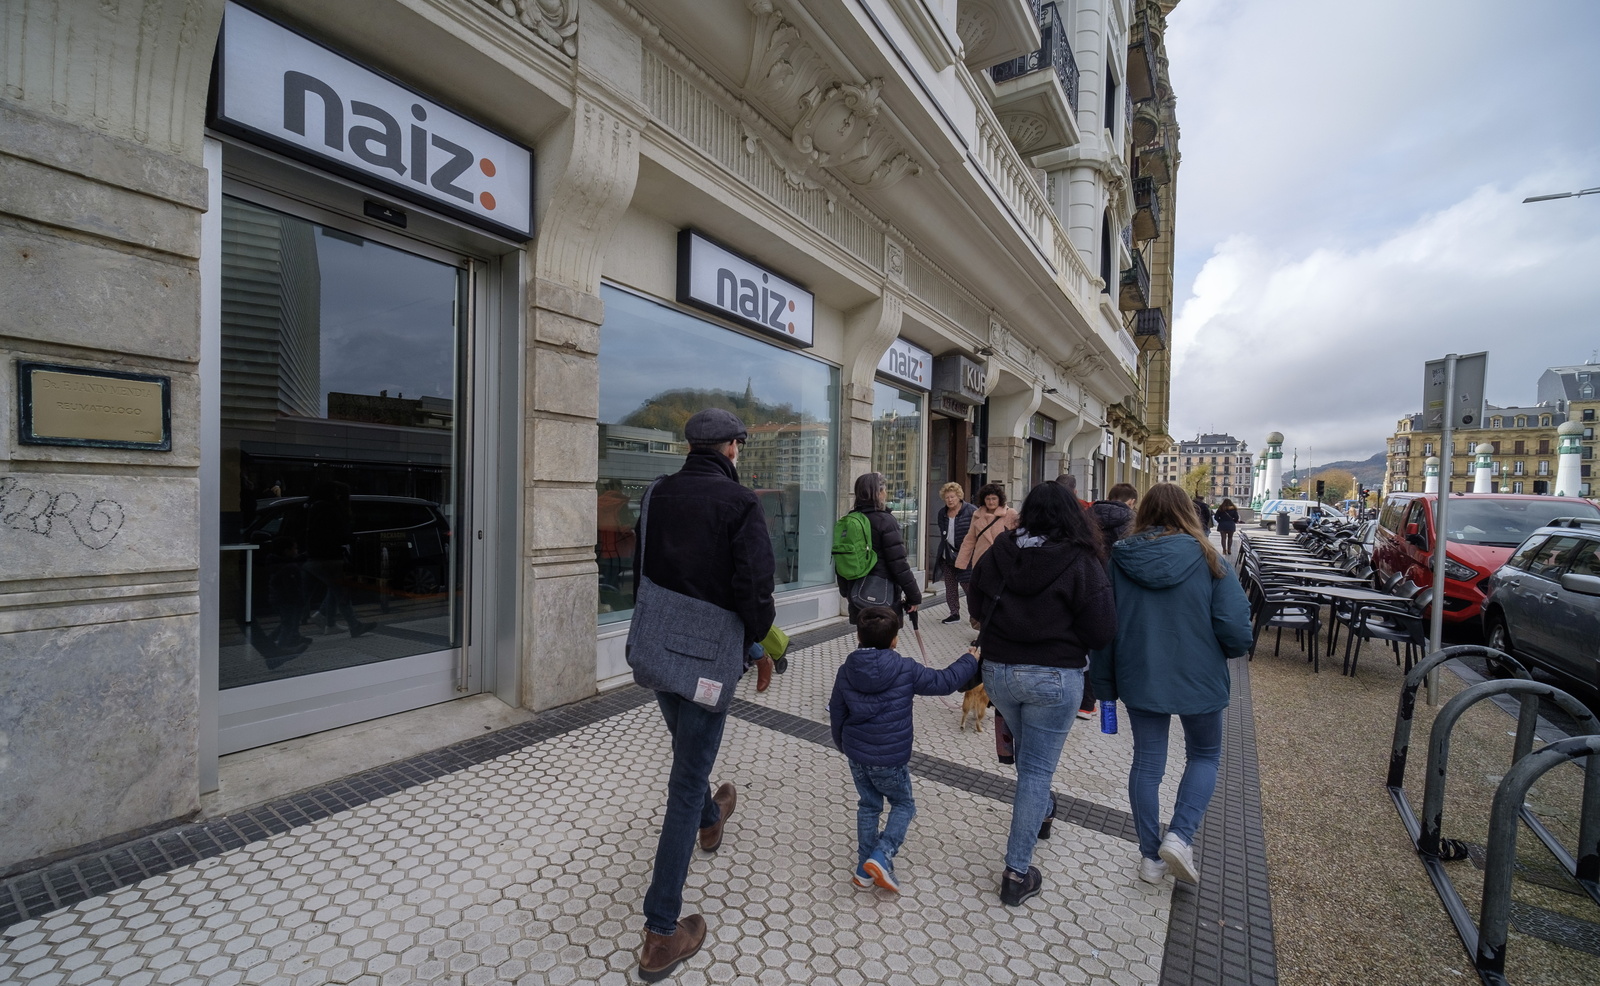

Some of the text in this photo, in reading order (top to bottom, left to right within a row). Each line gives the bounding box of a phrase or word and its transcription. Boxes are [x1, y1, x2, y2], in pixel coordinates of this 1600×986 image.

[283, 70, 496, 211] naiz:
[716, 267, 796, 335] naiz:
[889, 346, 923, 383] naiz:
[56, 401, 143, 416] REUMATOLOGO
